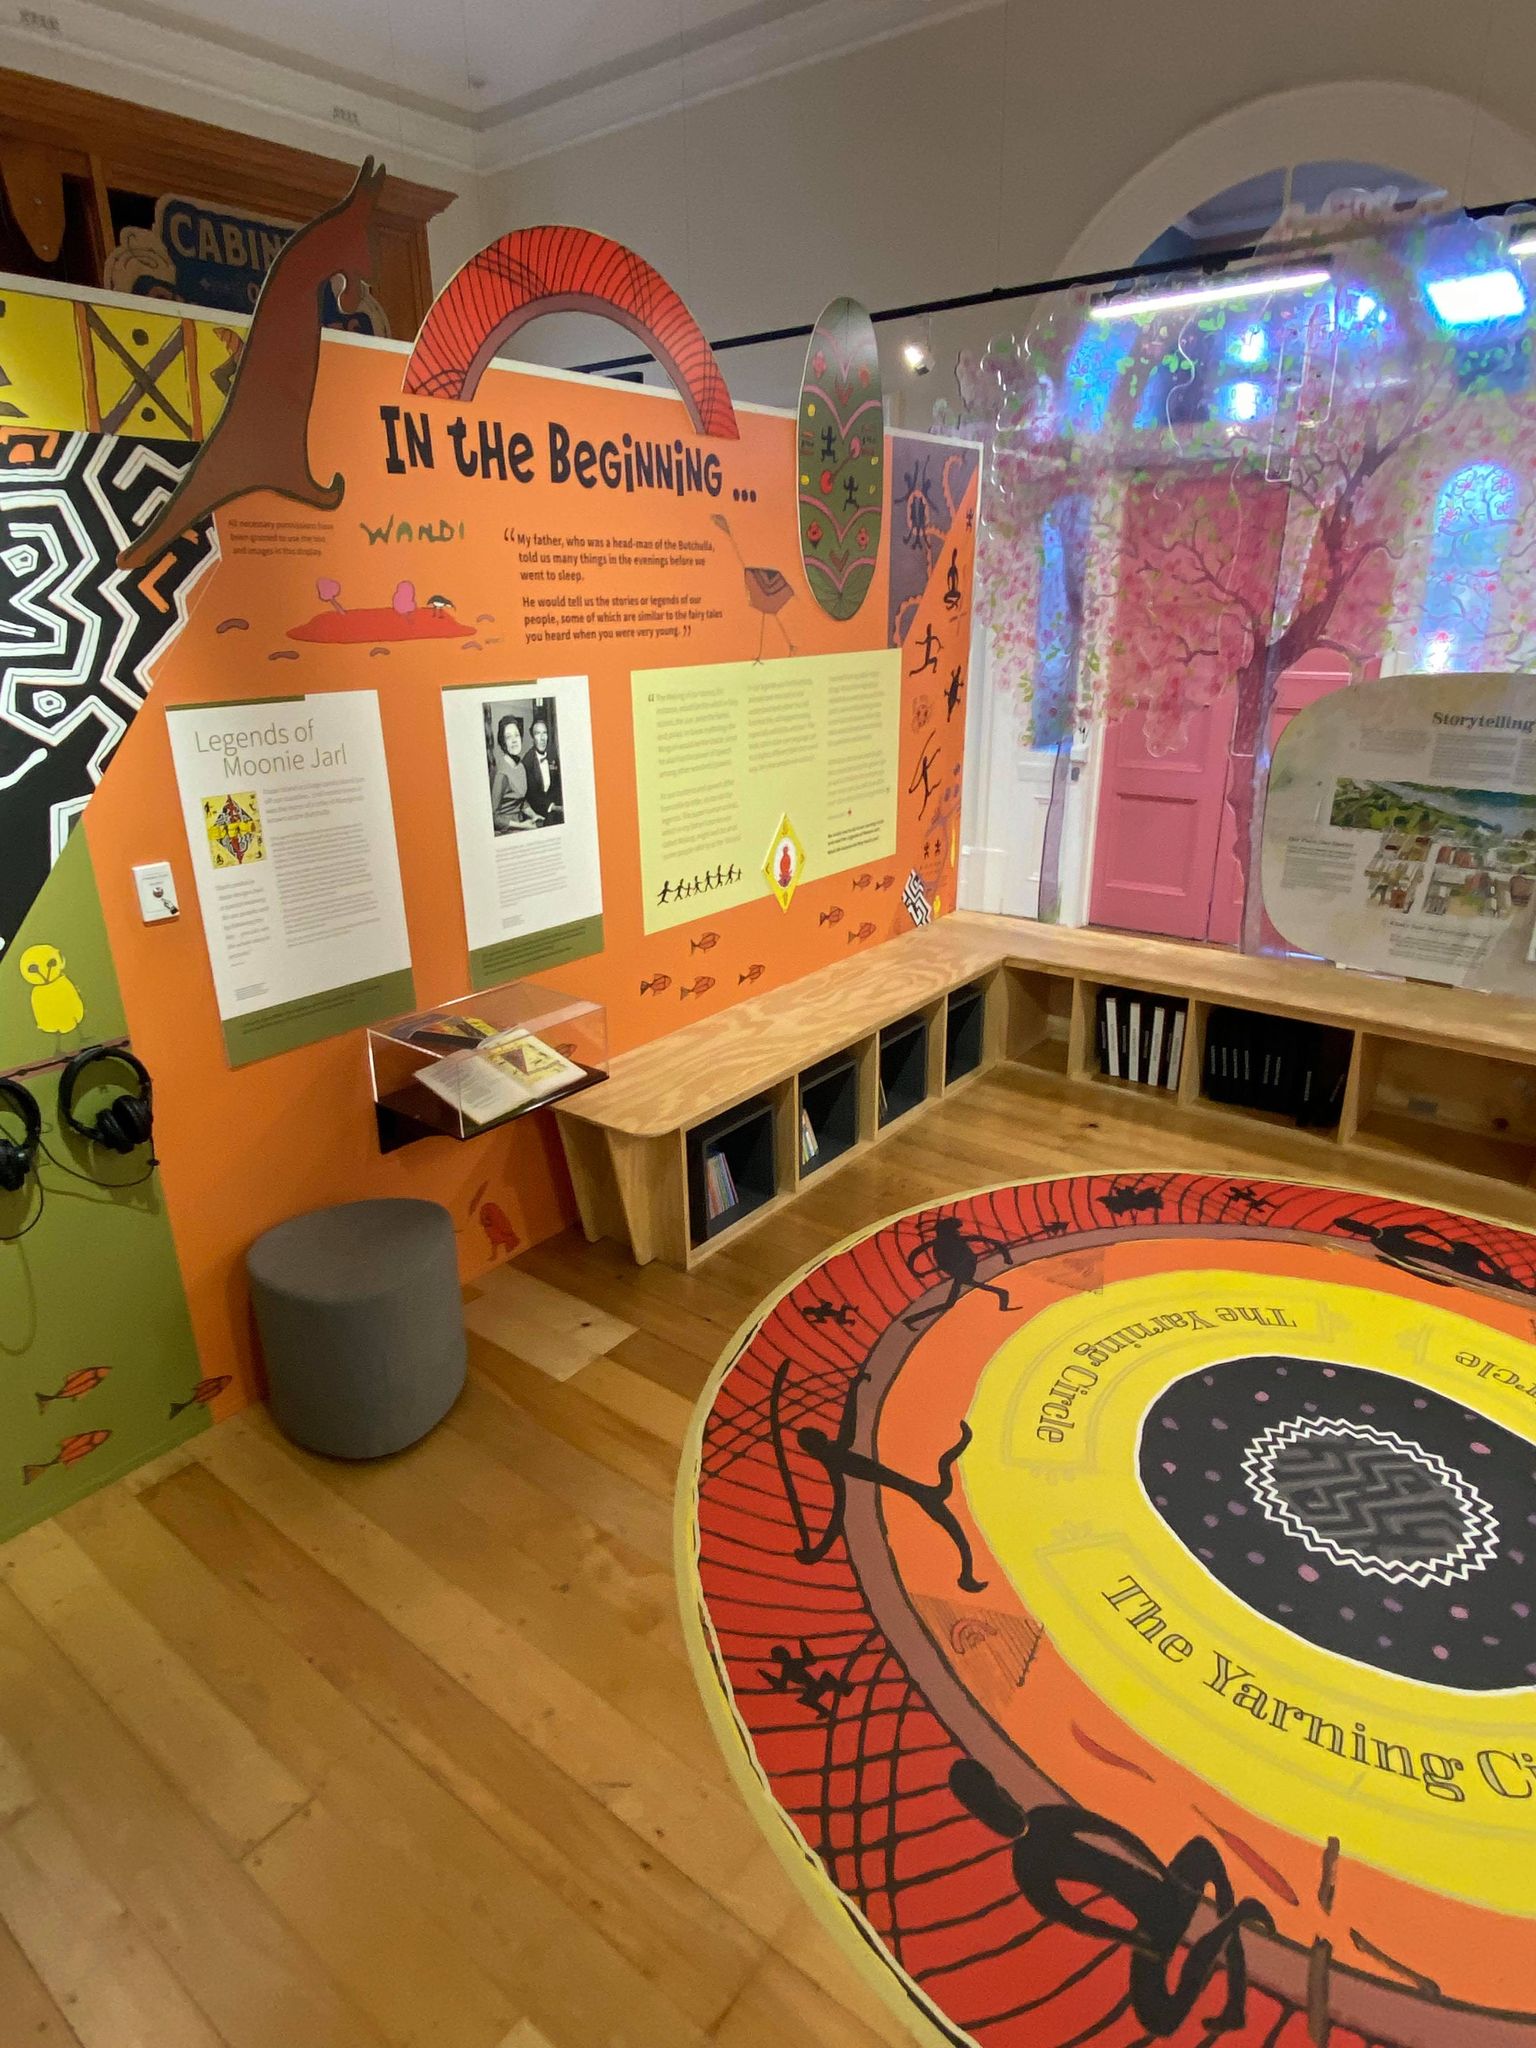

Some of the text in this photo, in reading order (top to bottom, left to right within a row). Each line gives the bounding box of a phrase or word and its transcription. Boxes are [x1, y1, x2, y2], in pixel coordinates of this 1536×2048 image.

[379, 405, 435, 475] IN
[359, 513, 465, 546] WANDI
[533, 532, 564, 549] father,
[566, 535, 586, 548] who
[587, 538, 605, 548] was
[606, 540, 611, 549] a
[654, 538, 663, 550] of
[664, 539, 677, 550] the
[519, 551, 538, 564] told
[540, 554, 552, 564] us
[552, 554, 579, 567] many
[580, 552, 608, 568] things
[608, 555, 617, 566] in
[618, 554, 632, 566] the
[520, 570, 545, 581] went
[546, 569, 557, 581] to
[522, 595, 536, 608] He
[537, 595, 566, 608] would
[567, 594, 583, 607] tell
[584, 597, 595, 607] us
[595, 594, 610, 607] the
[612, 594, 640, 607] stories
[640, 597, 650, 606] or
[524, 614, 560, 628] people,
[560, 612, 585, 624] some
[585, 611, 596, 624] of
[596, 610, 622, 623] which
[623, 612, 636, 622] are
[665, 610, 674, 621] to
[688, 608, 705, 622] fairy
[525, 630, 543, 645] you
[544, 628, 571, 641] heard
[572, 628, 597, 641] when
[598, 629, 614, 642] you
[615, 628, 635, 639] were
[636, 627, 654, 640] very
[1432, 711, 1536, 734] Storytelling
[194, 718, 315, 757] Legends of
[223, 743, 348, 779] Moonie Jarl
[1036, 1306, 1298, 1444] The Yarning Circle
[1101, 1575, 1194, 1664] The
[1203, 1650, 1465, 1802] Yarning
